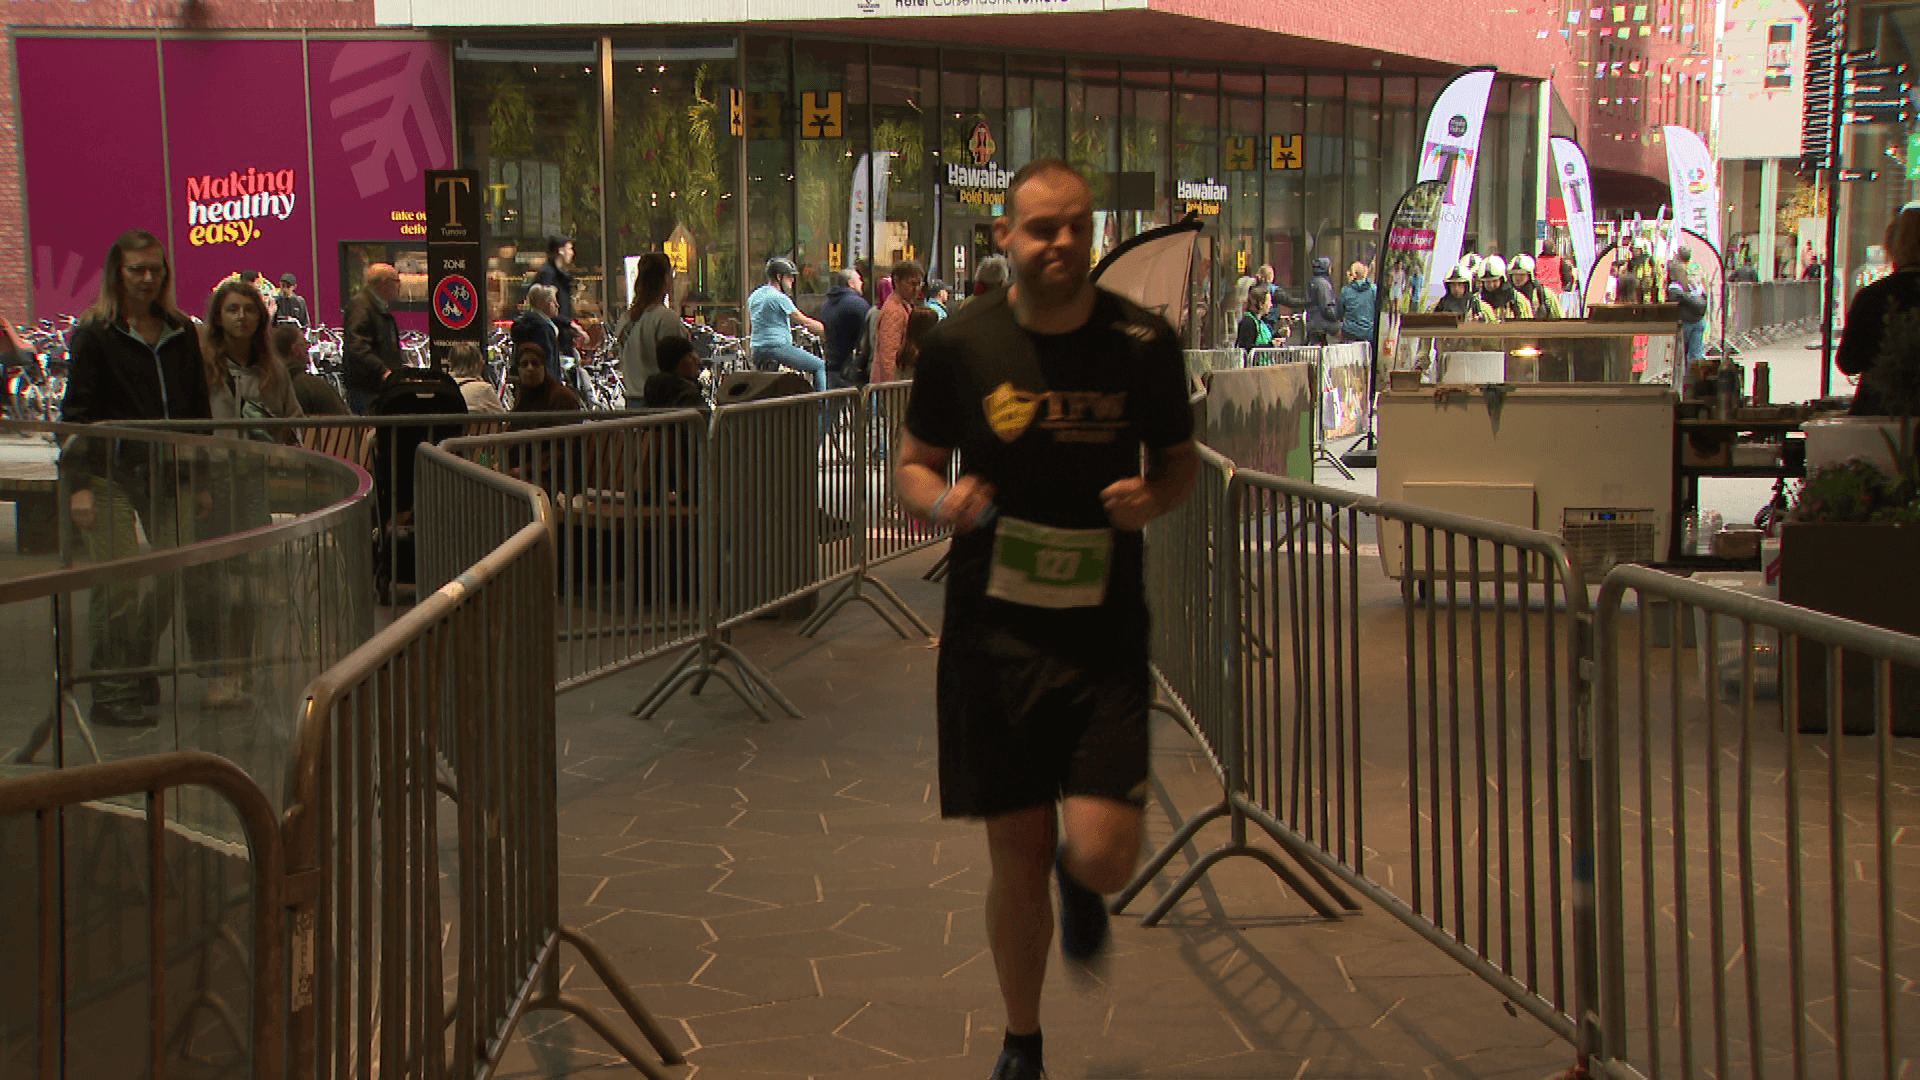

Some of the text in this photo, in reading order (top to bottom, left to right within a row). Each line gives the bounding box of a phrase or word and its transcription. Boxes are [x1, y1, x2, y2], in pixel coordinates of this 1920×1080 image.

[187, 167, 295, 201] Making
[1178, 177, 1228, 202] Hawaiian
[188, 192, 295, 226] healthy
[391, 209, 414, 221] take
[189, 219, 261, 246] easy.
[401, 223, 427, 235] deliv
[443, 259, 466, 270] ZONE
